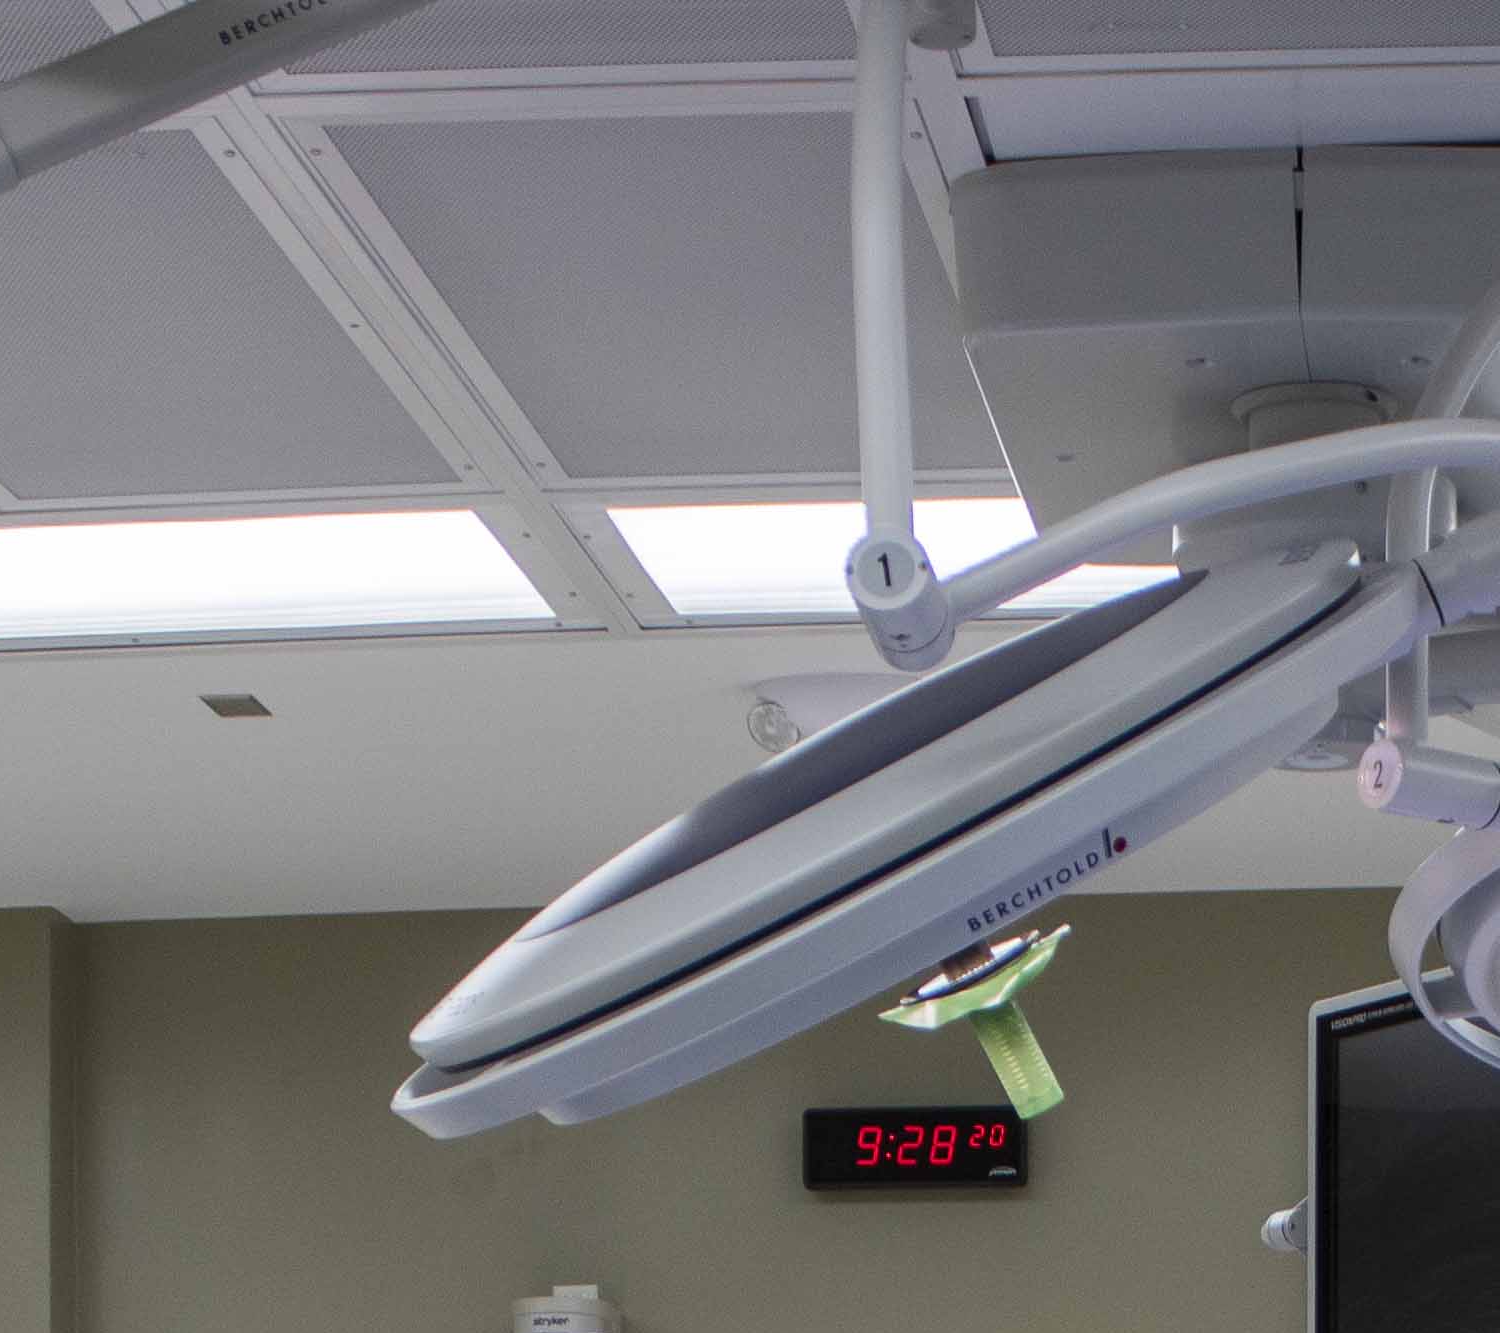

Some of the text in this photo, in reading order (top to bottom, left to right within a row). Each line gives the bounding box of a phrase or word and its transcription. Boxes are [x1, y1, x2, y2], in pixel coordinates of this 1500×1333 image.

[877, 552, 892, 588] 1
[1373, 759, 1384, 789] 2
[966, 848, 1101, 934] BERCHTOLD
[855, 1124, 1006, 1166] 9:28 20
